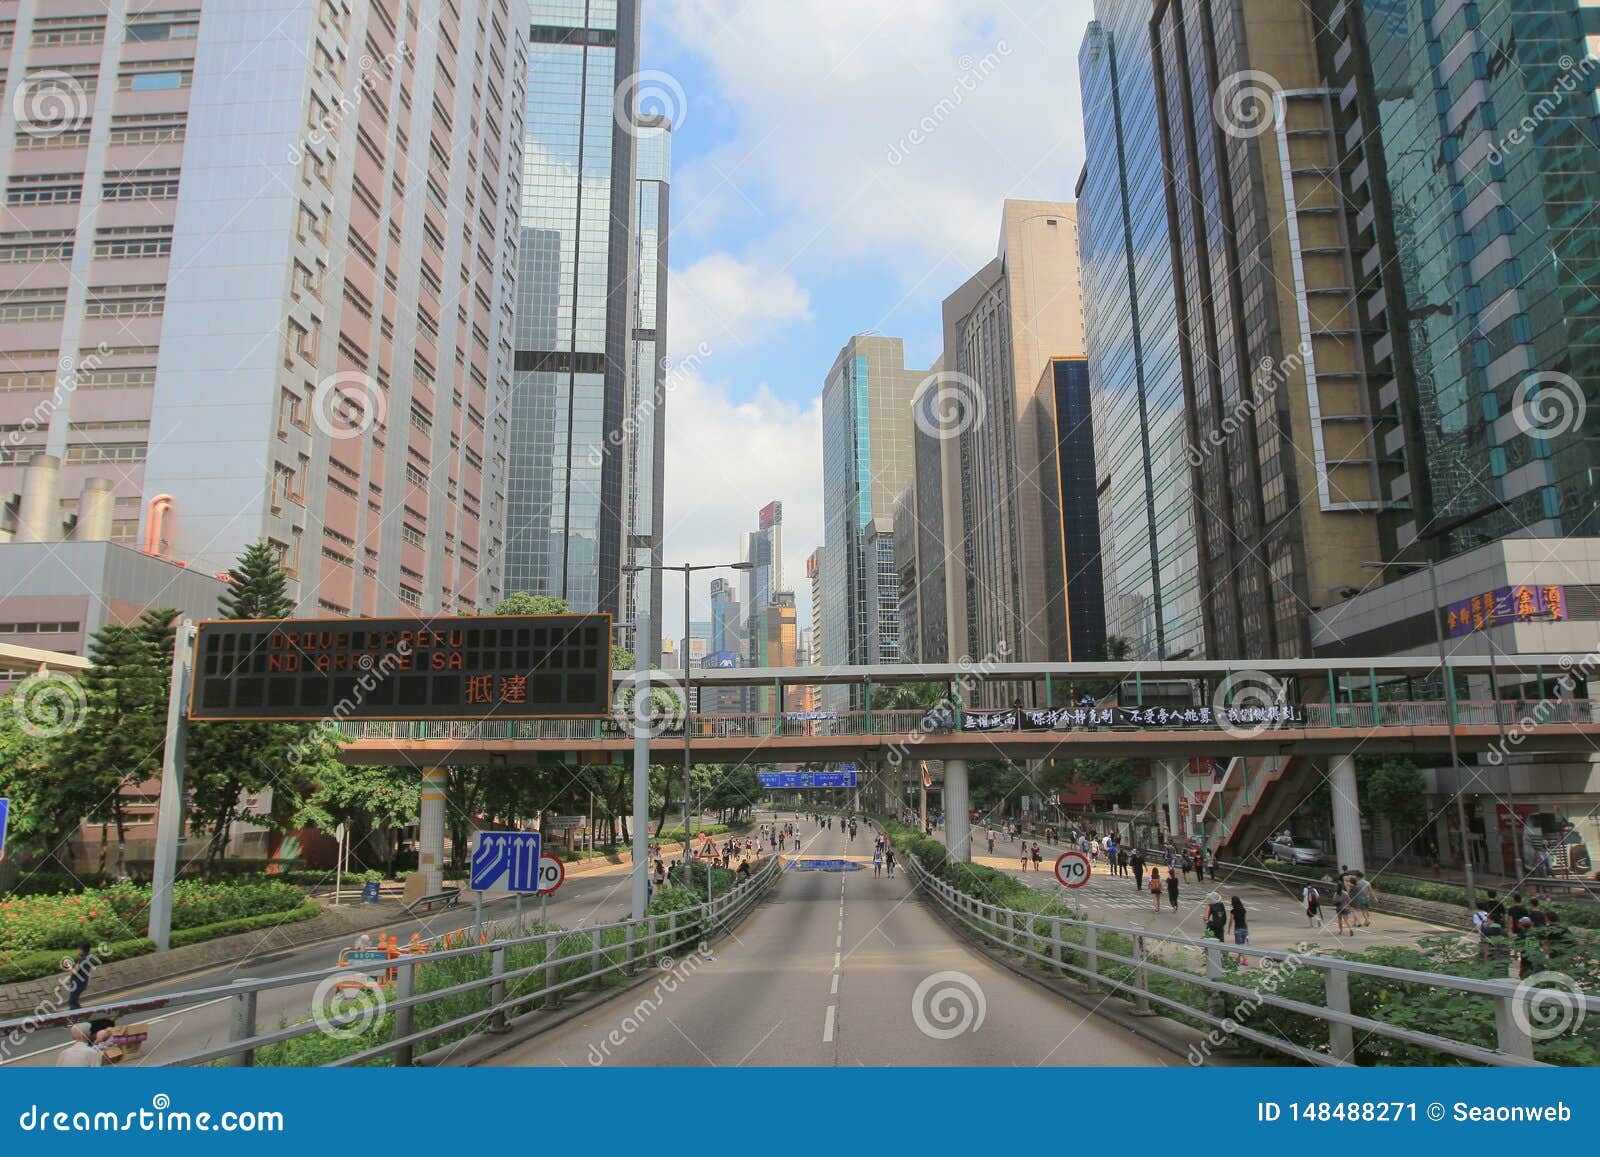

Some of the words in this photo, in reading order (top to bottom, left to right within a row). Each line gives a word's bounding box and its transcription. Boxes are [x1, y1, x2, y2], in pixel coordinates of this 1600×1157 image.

[271, 632, 348, 650] DRIVE
[269, 654, 299, 672] ND
[432, 651, 463, 670] SA
[465, 675, 526, 704] 抵達
[1061, 862, 1085, 878] 70
